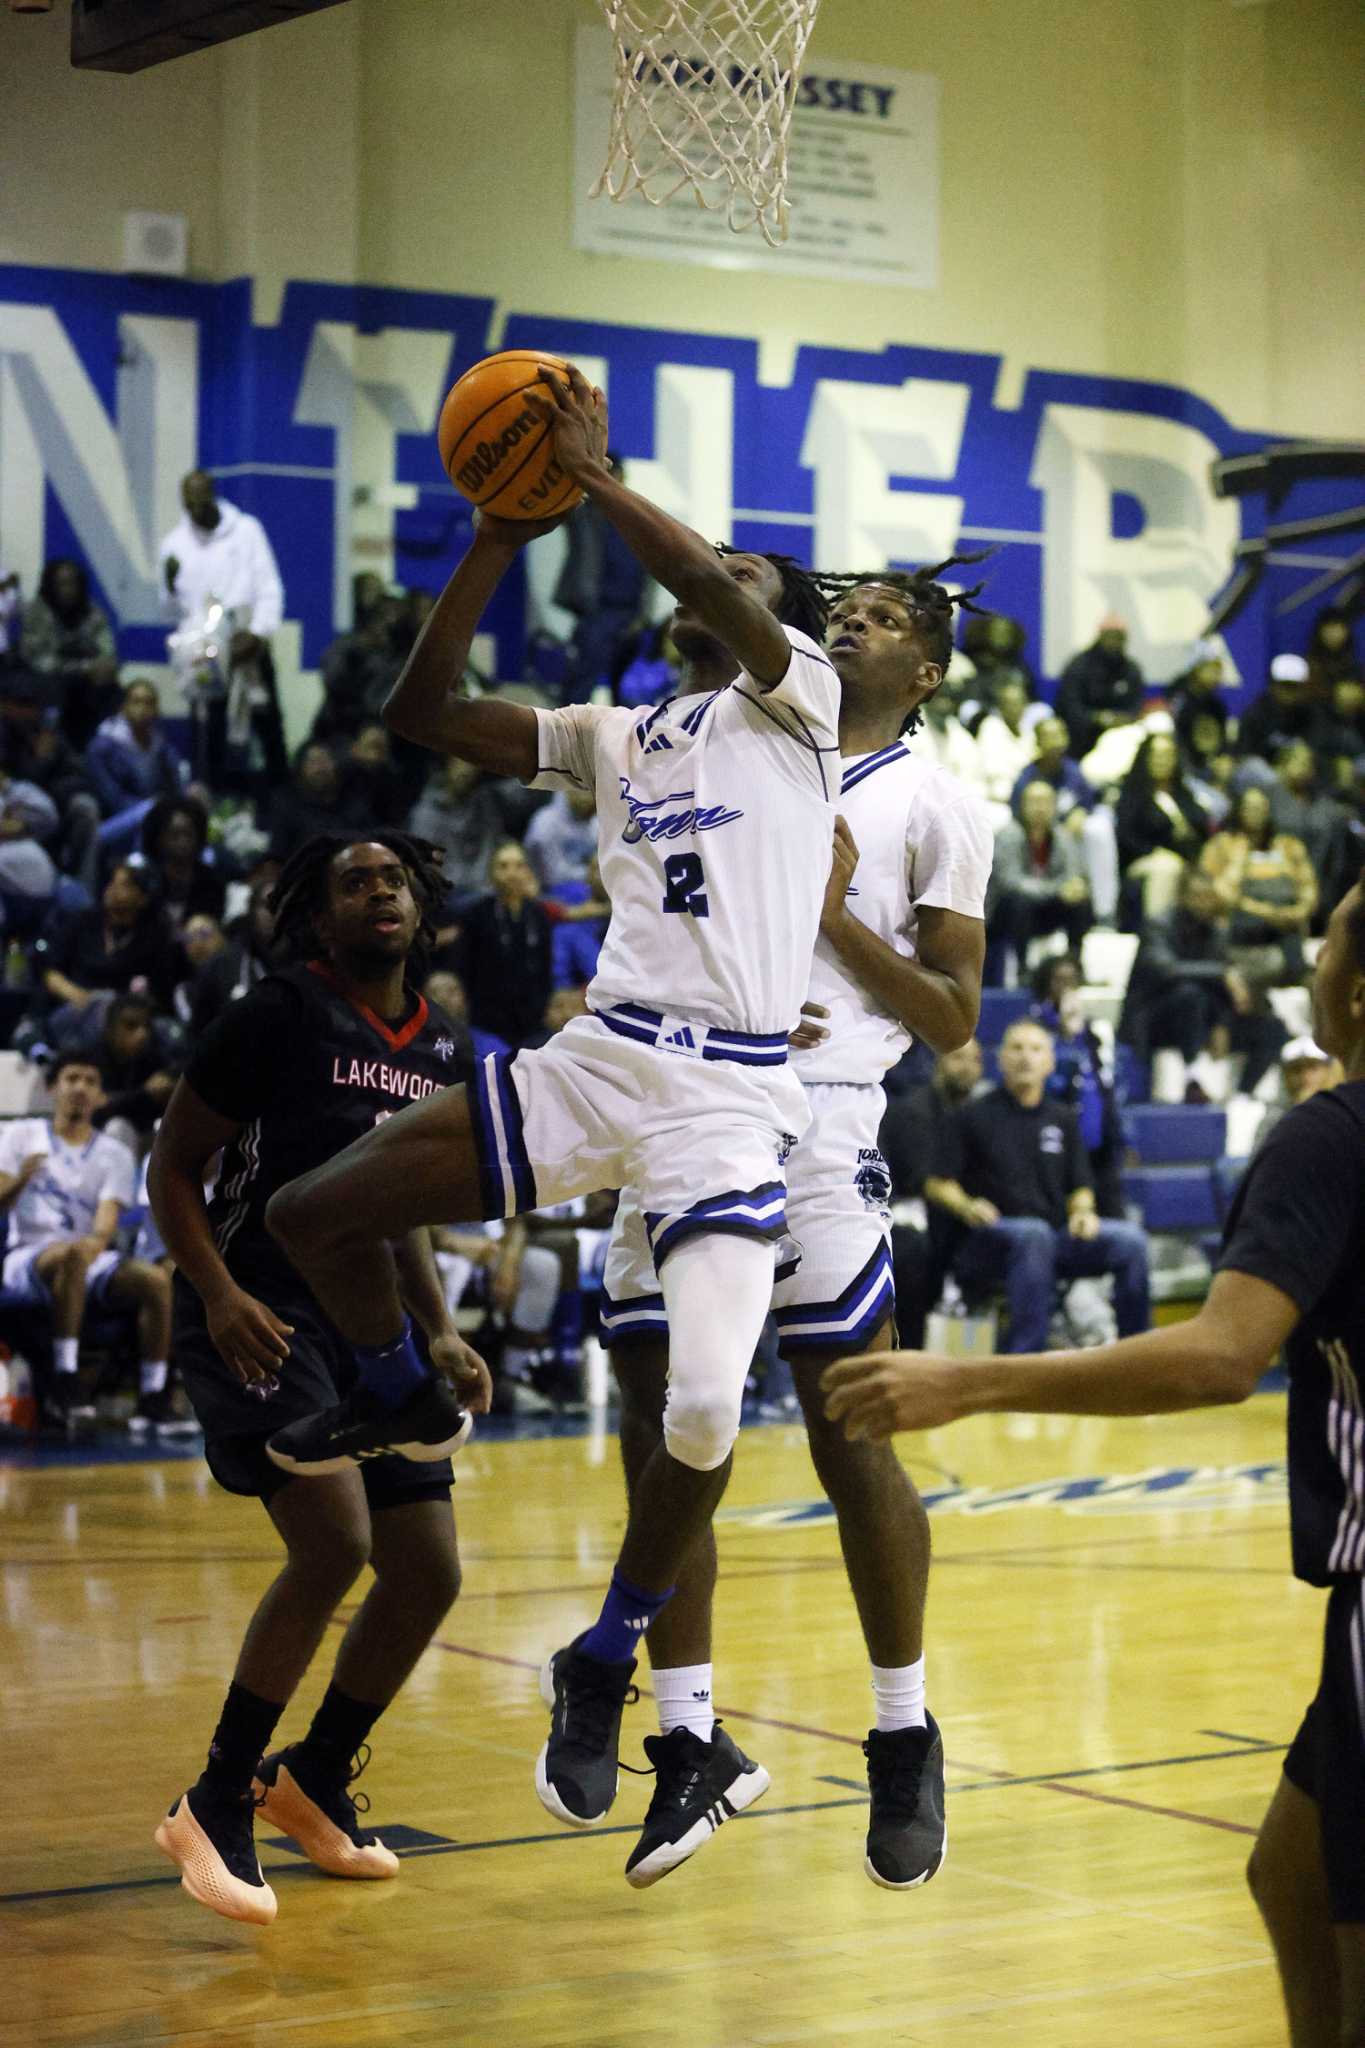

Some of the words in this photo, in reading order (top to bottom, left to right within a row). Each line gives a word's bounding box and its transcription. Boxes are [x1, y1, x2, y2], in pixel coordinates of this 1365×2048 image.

[457, 410, 540, 493] Wilson
[662, 852, 709, 918] 2
[332, 1057, 446, 1101] LAKEWOO
